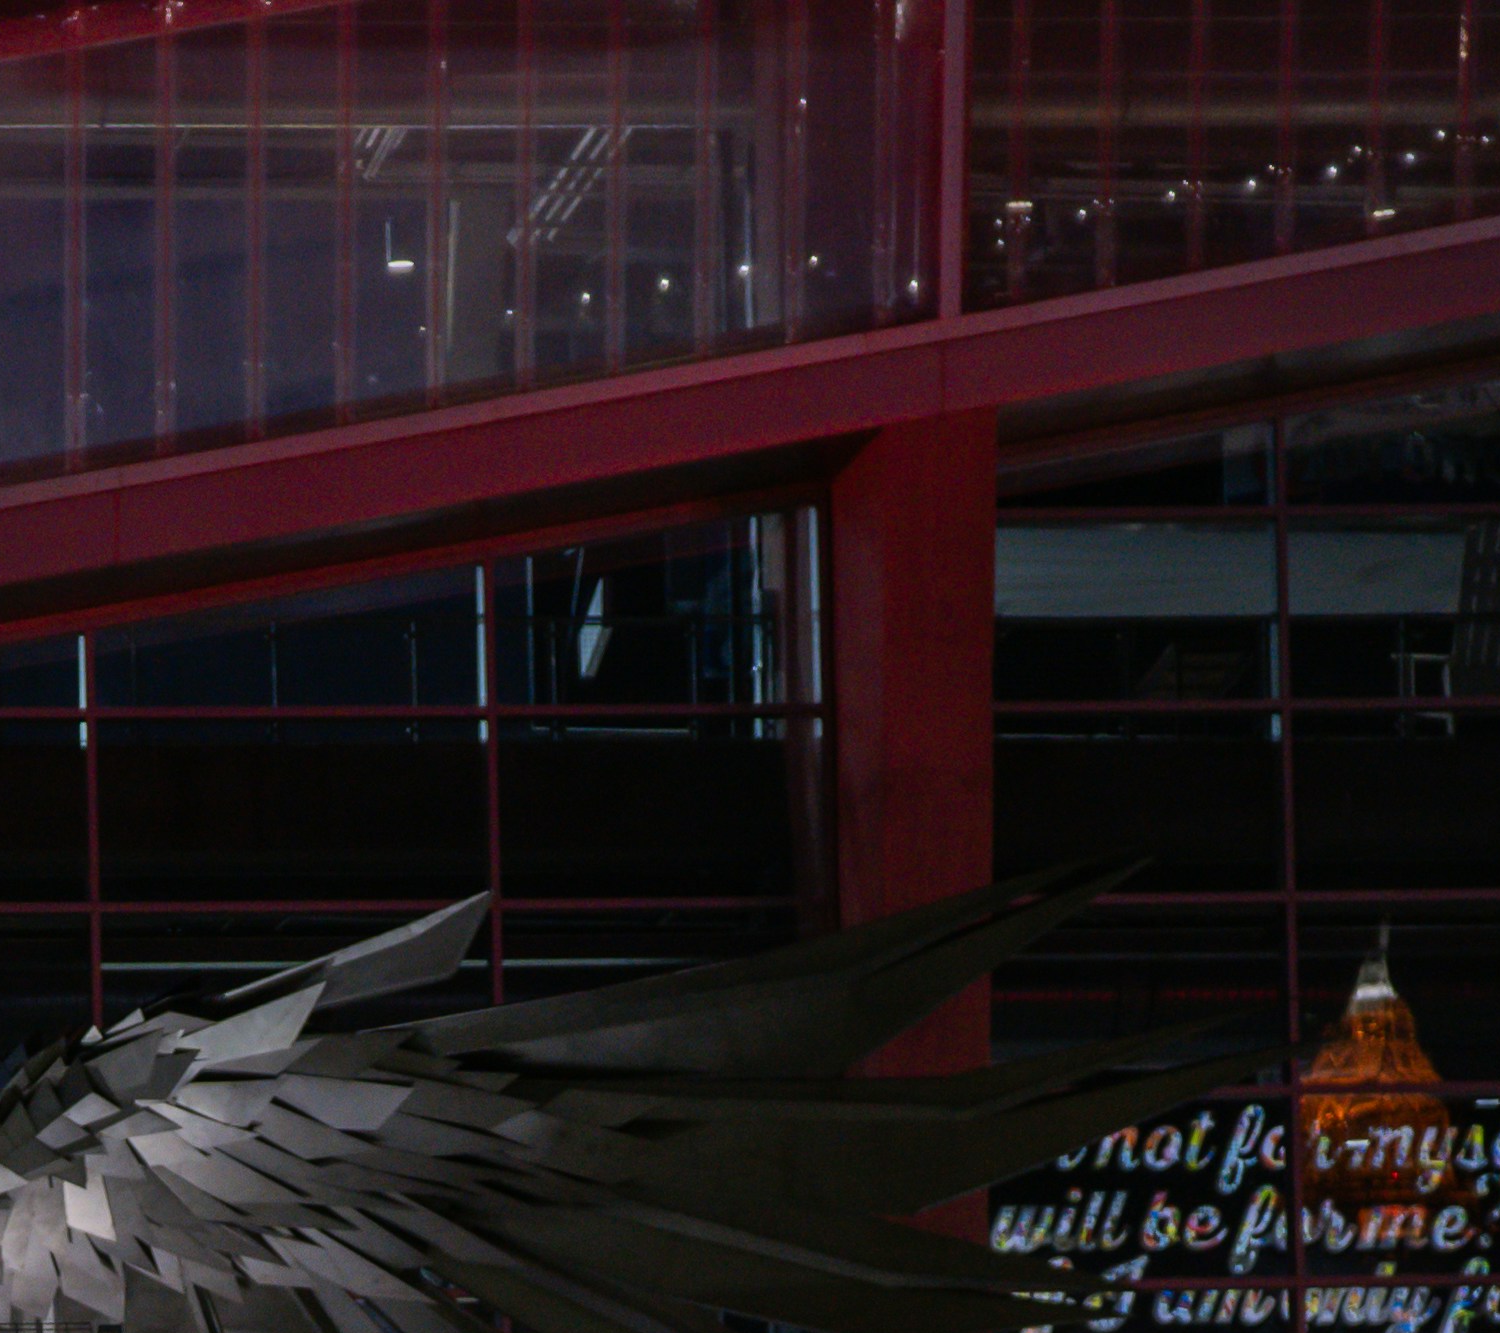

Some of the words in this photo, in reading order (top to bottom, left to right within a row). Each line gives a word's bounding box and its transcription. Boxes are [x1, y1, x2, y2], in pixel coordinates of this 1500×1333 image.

[1091, 1109, 1217, 1173] not
[989, 1187, 1129, 1254] will
[1140, 1188, 1230, 1251] be
[1227, 1184, 1358, 1276] for
